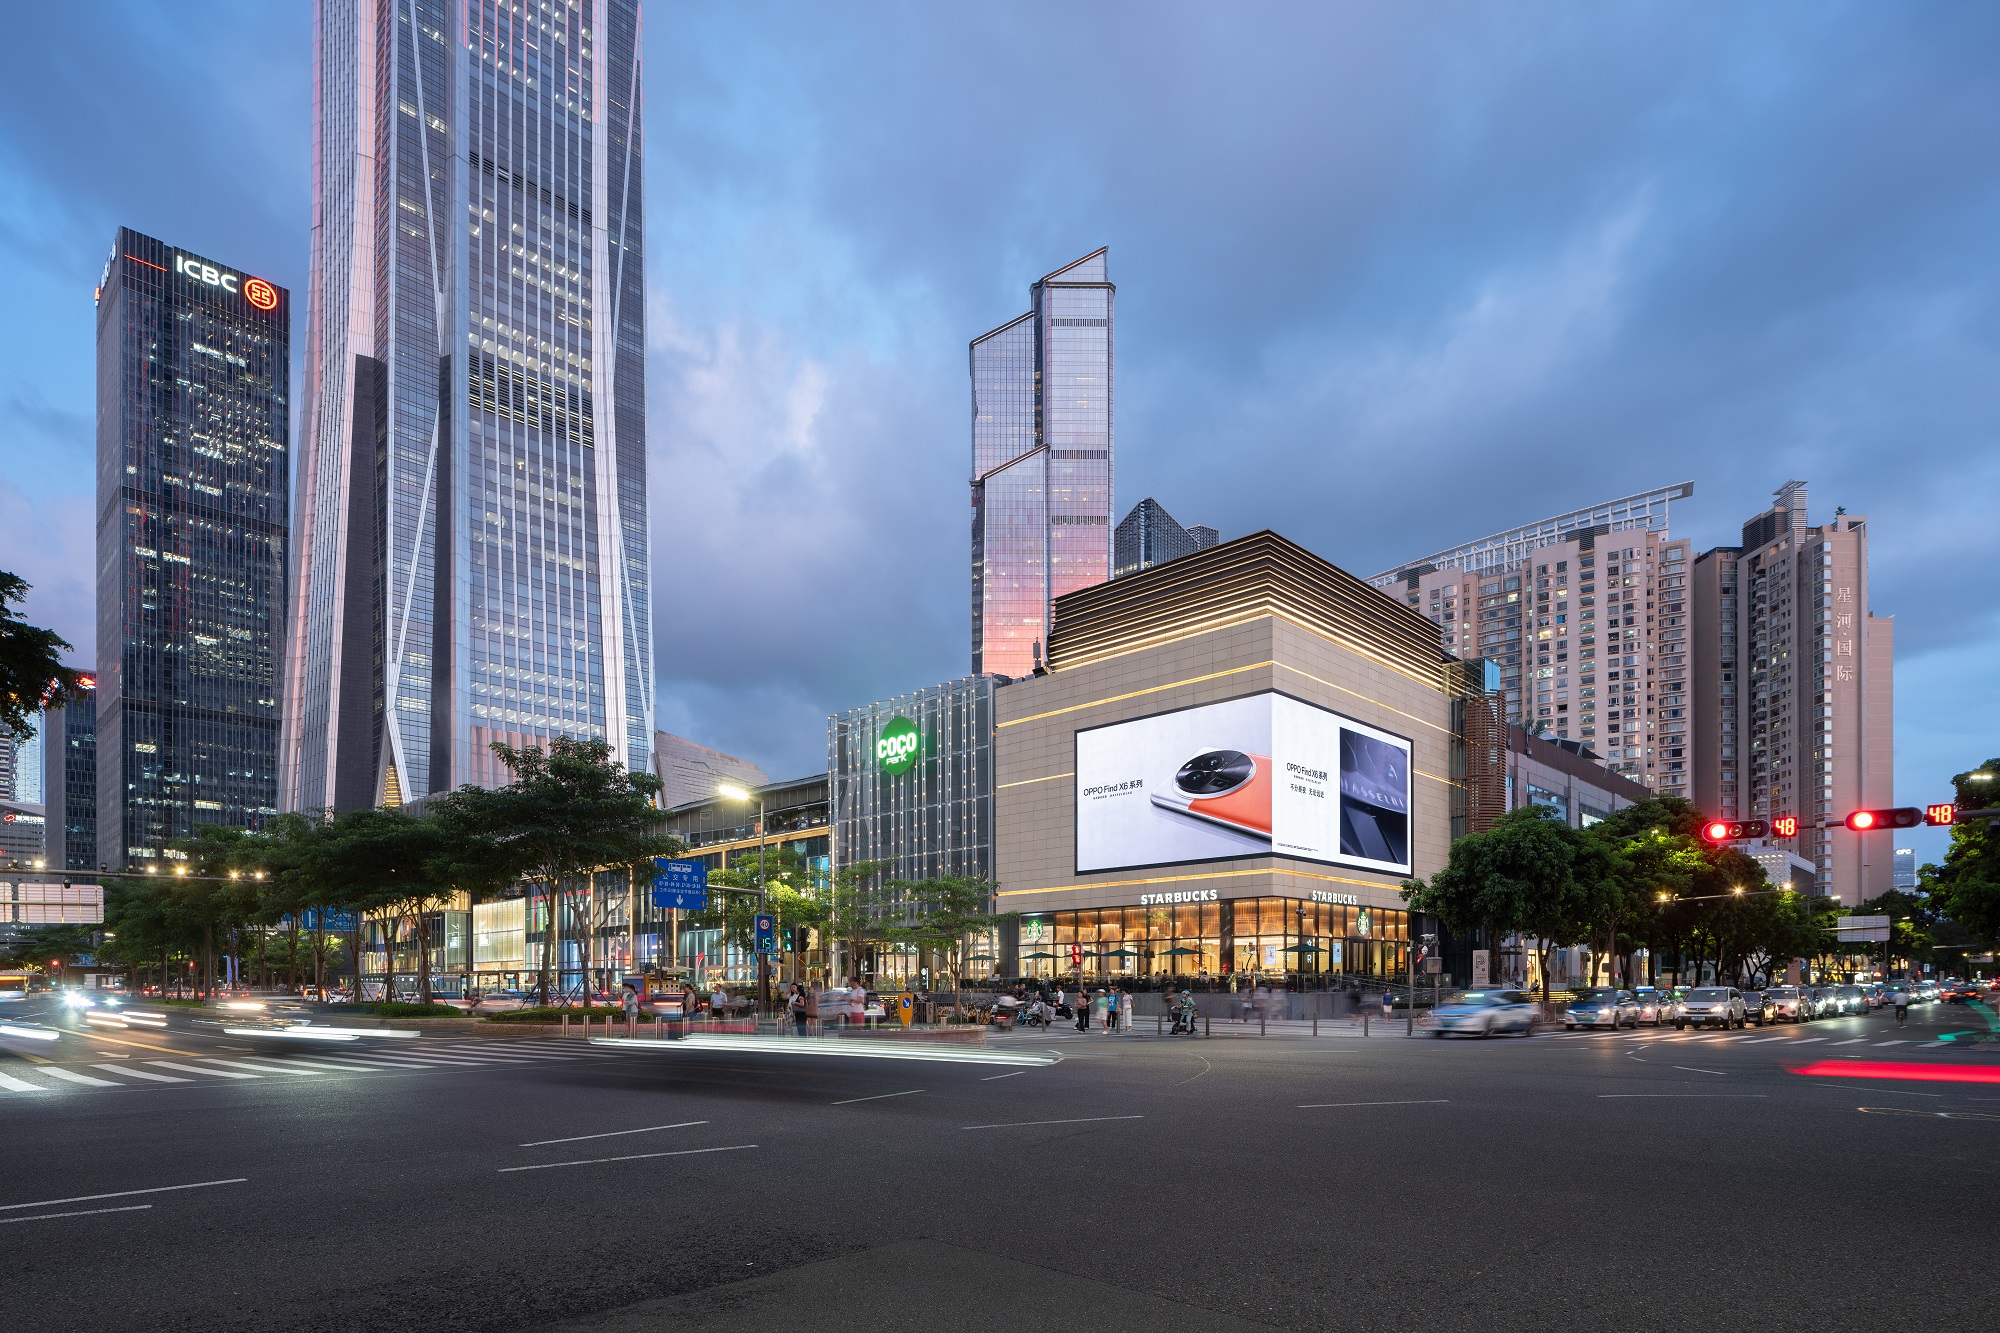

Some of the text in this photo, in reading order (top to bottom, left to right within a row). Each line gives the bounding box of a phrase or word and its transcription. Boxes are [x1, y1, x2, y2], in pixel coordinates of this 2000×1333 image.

[177, 255, 237, 293] ICBC
[878, 732, 917, 759] COCO
[1286, 762, 1301, 774] OPPO
[1301, 766, 1311, 777] Find
[1312, 769, 1319, 779] X6
[1083, 786, 1104, 797] OPPO
[1103, 784, 1118, 794] Find
[1118, 781, 1129, 791] X6
[1929, 805, 1952, 824] 48
[1775, 818, 1795, 836] 48
[662, 873, 699, 883] 公交专用
[1140, 889, 1218, 905] STARBUCKS
[1312, 890, 1358, 906] STARBUCKS
[760, 920, 769, 928] 40
[762, 937, 771, 949] 15
